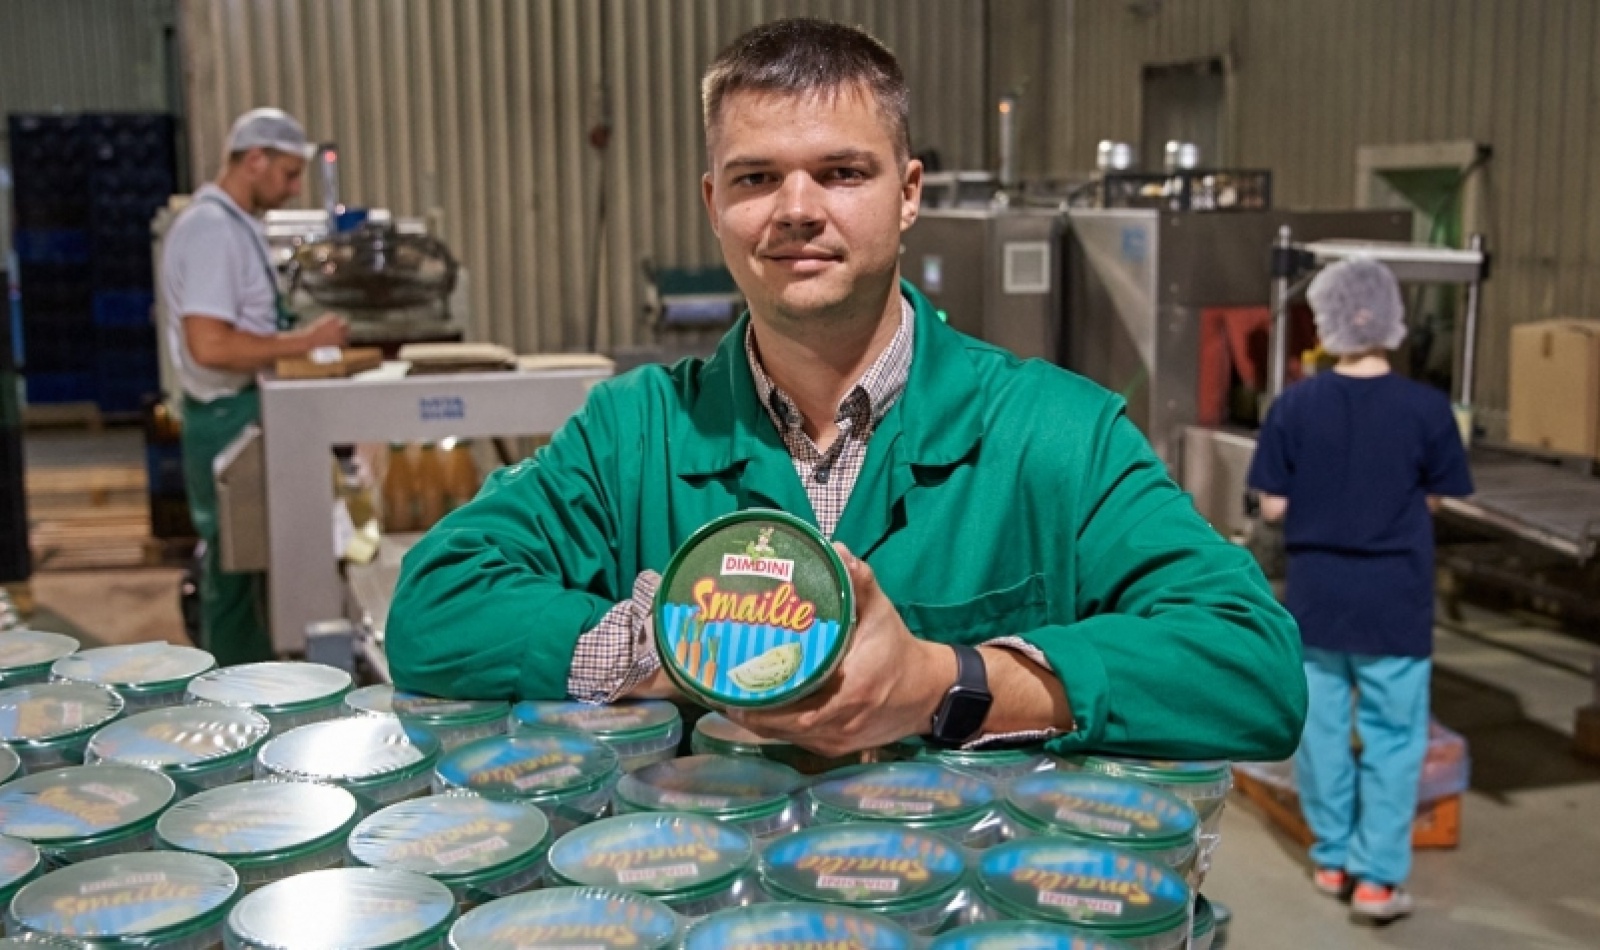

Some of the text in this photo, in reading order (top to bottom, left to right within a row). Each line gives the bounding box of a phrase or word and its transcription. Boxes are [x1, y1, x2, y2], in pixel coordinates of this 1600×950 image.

[726, 557, 791, 576] DIMDINI
[693, 577, 816, 632] Smailie
[1013, 867, 1150, 905] Smailie
